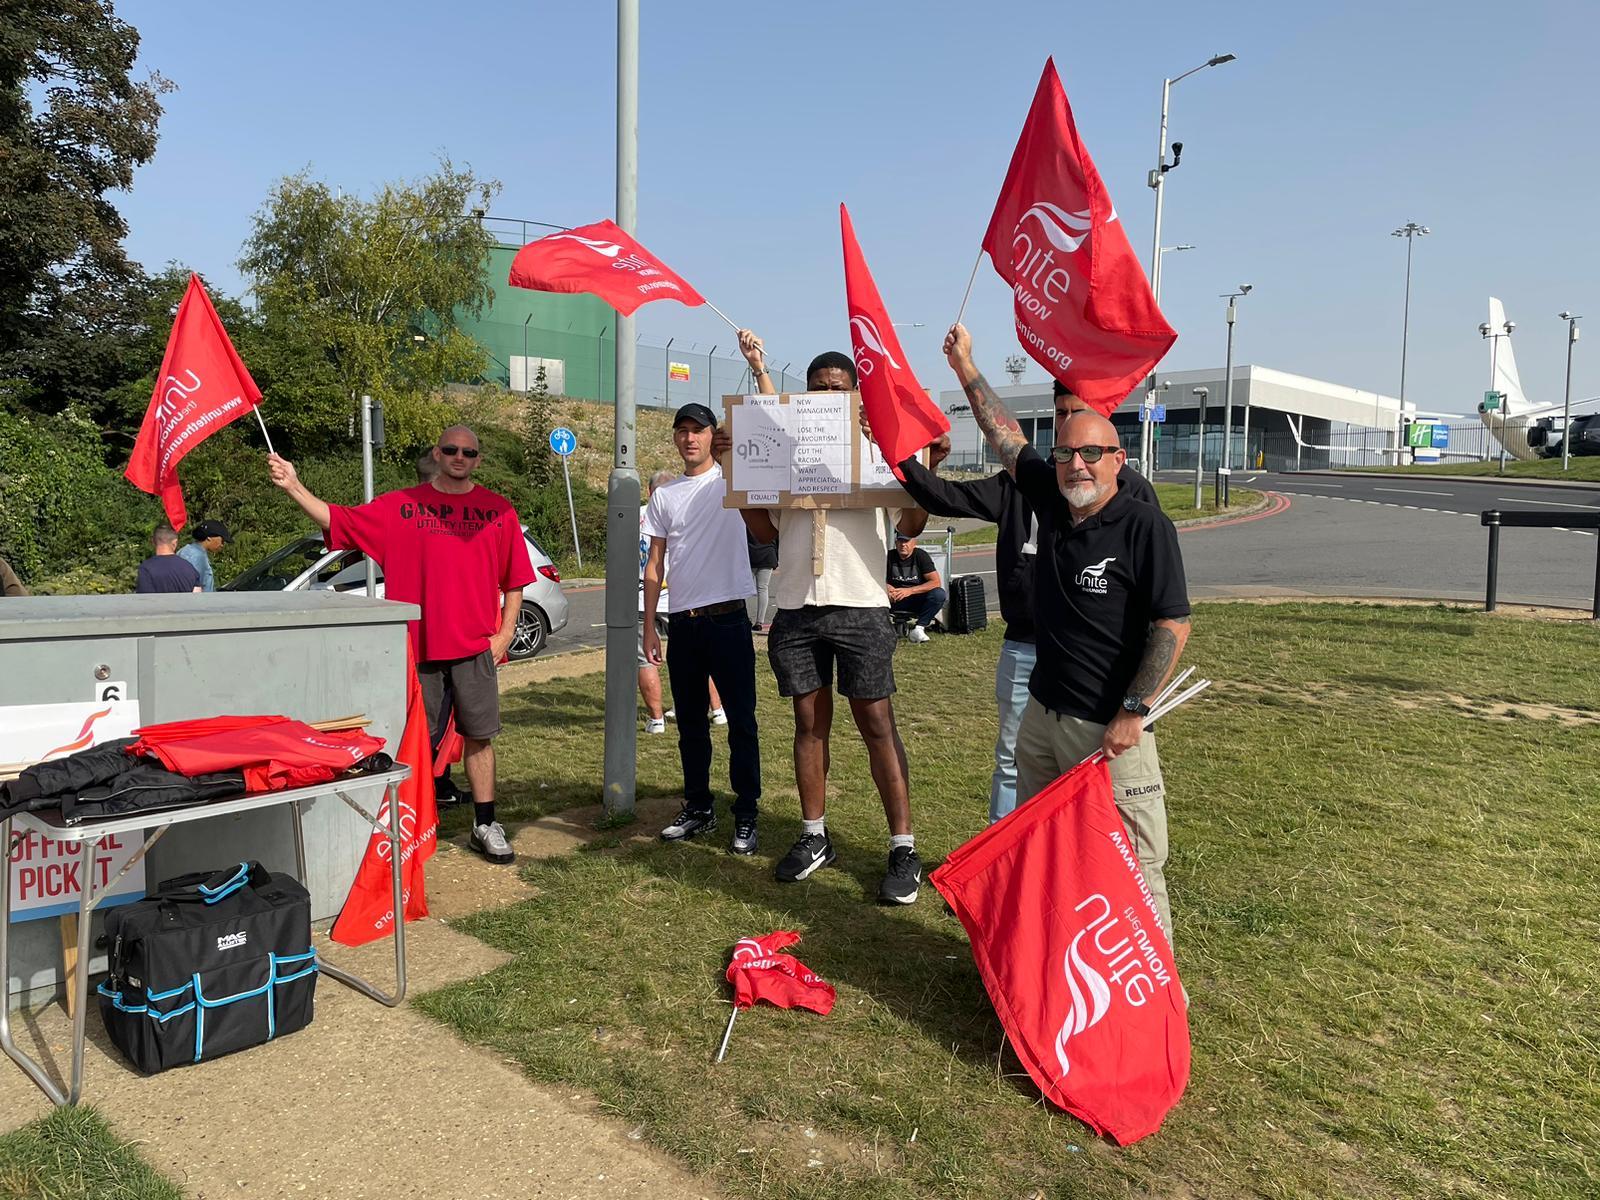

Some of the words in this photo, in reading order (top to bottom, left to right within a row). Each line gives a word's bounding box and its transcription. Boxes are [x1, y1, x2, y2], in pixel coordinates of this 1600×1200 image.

[1011, 232, 1071, 304] nite
[1014, 281, 1052, 321] NION
[1015, 319, 1073, 371] union.org
[400, 502, 454, 520] GASP
[417, 520, 457, 529] UTILITY
[20, 856, 113, 901] PICKT
[217, 931, 247, 945] MAC
